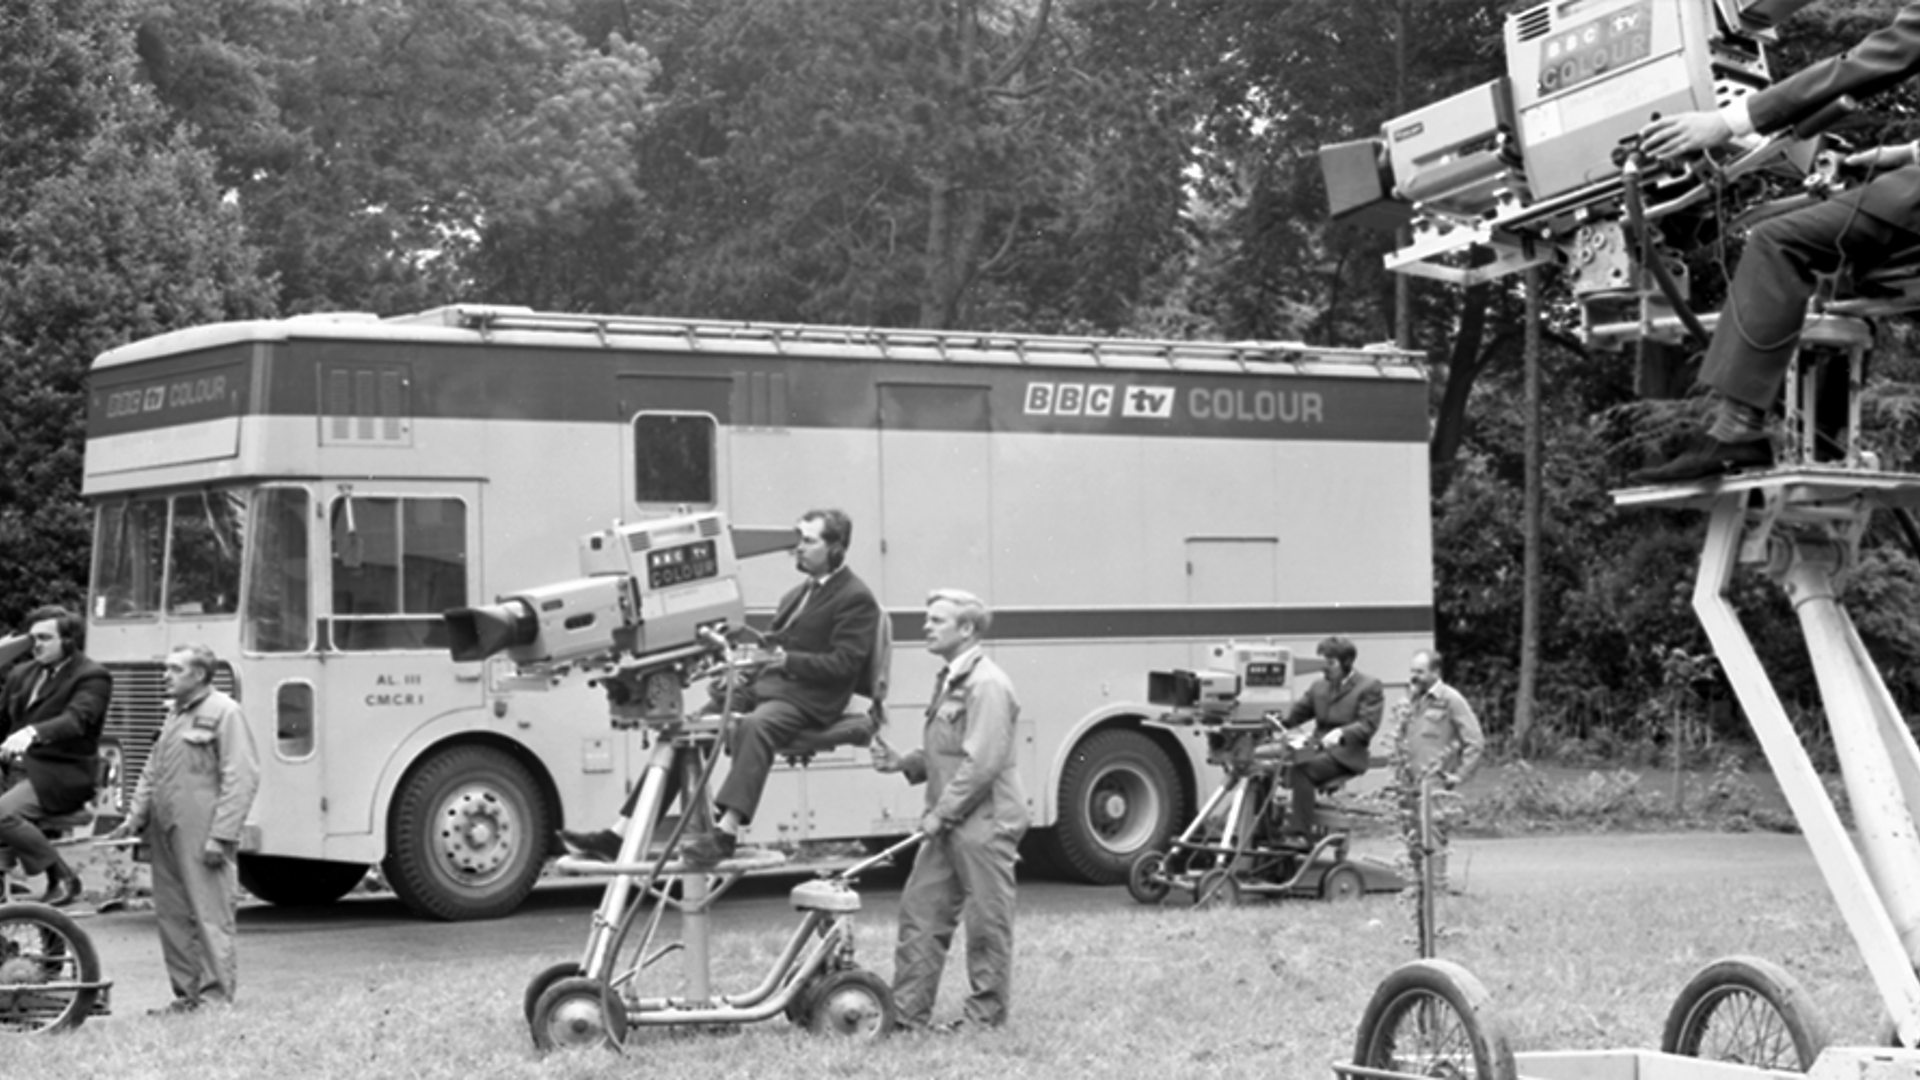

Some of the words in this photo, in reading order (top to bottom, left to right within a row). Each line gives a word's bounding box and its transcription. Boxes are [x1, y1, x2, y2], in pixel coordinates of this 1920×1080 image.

[1547, 26, 1597, 59] BBC
[1541, 33, 1646, 89] COLOUR
[168, 375, 226, 407] COLOUR
[1024, 382, 1115, 417] BBC
[1122, 385, 1176, 418] tv
[1188, 387, 1324, 423] COLOUR
[650, 560, 714, 587] COLOUR
